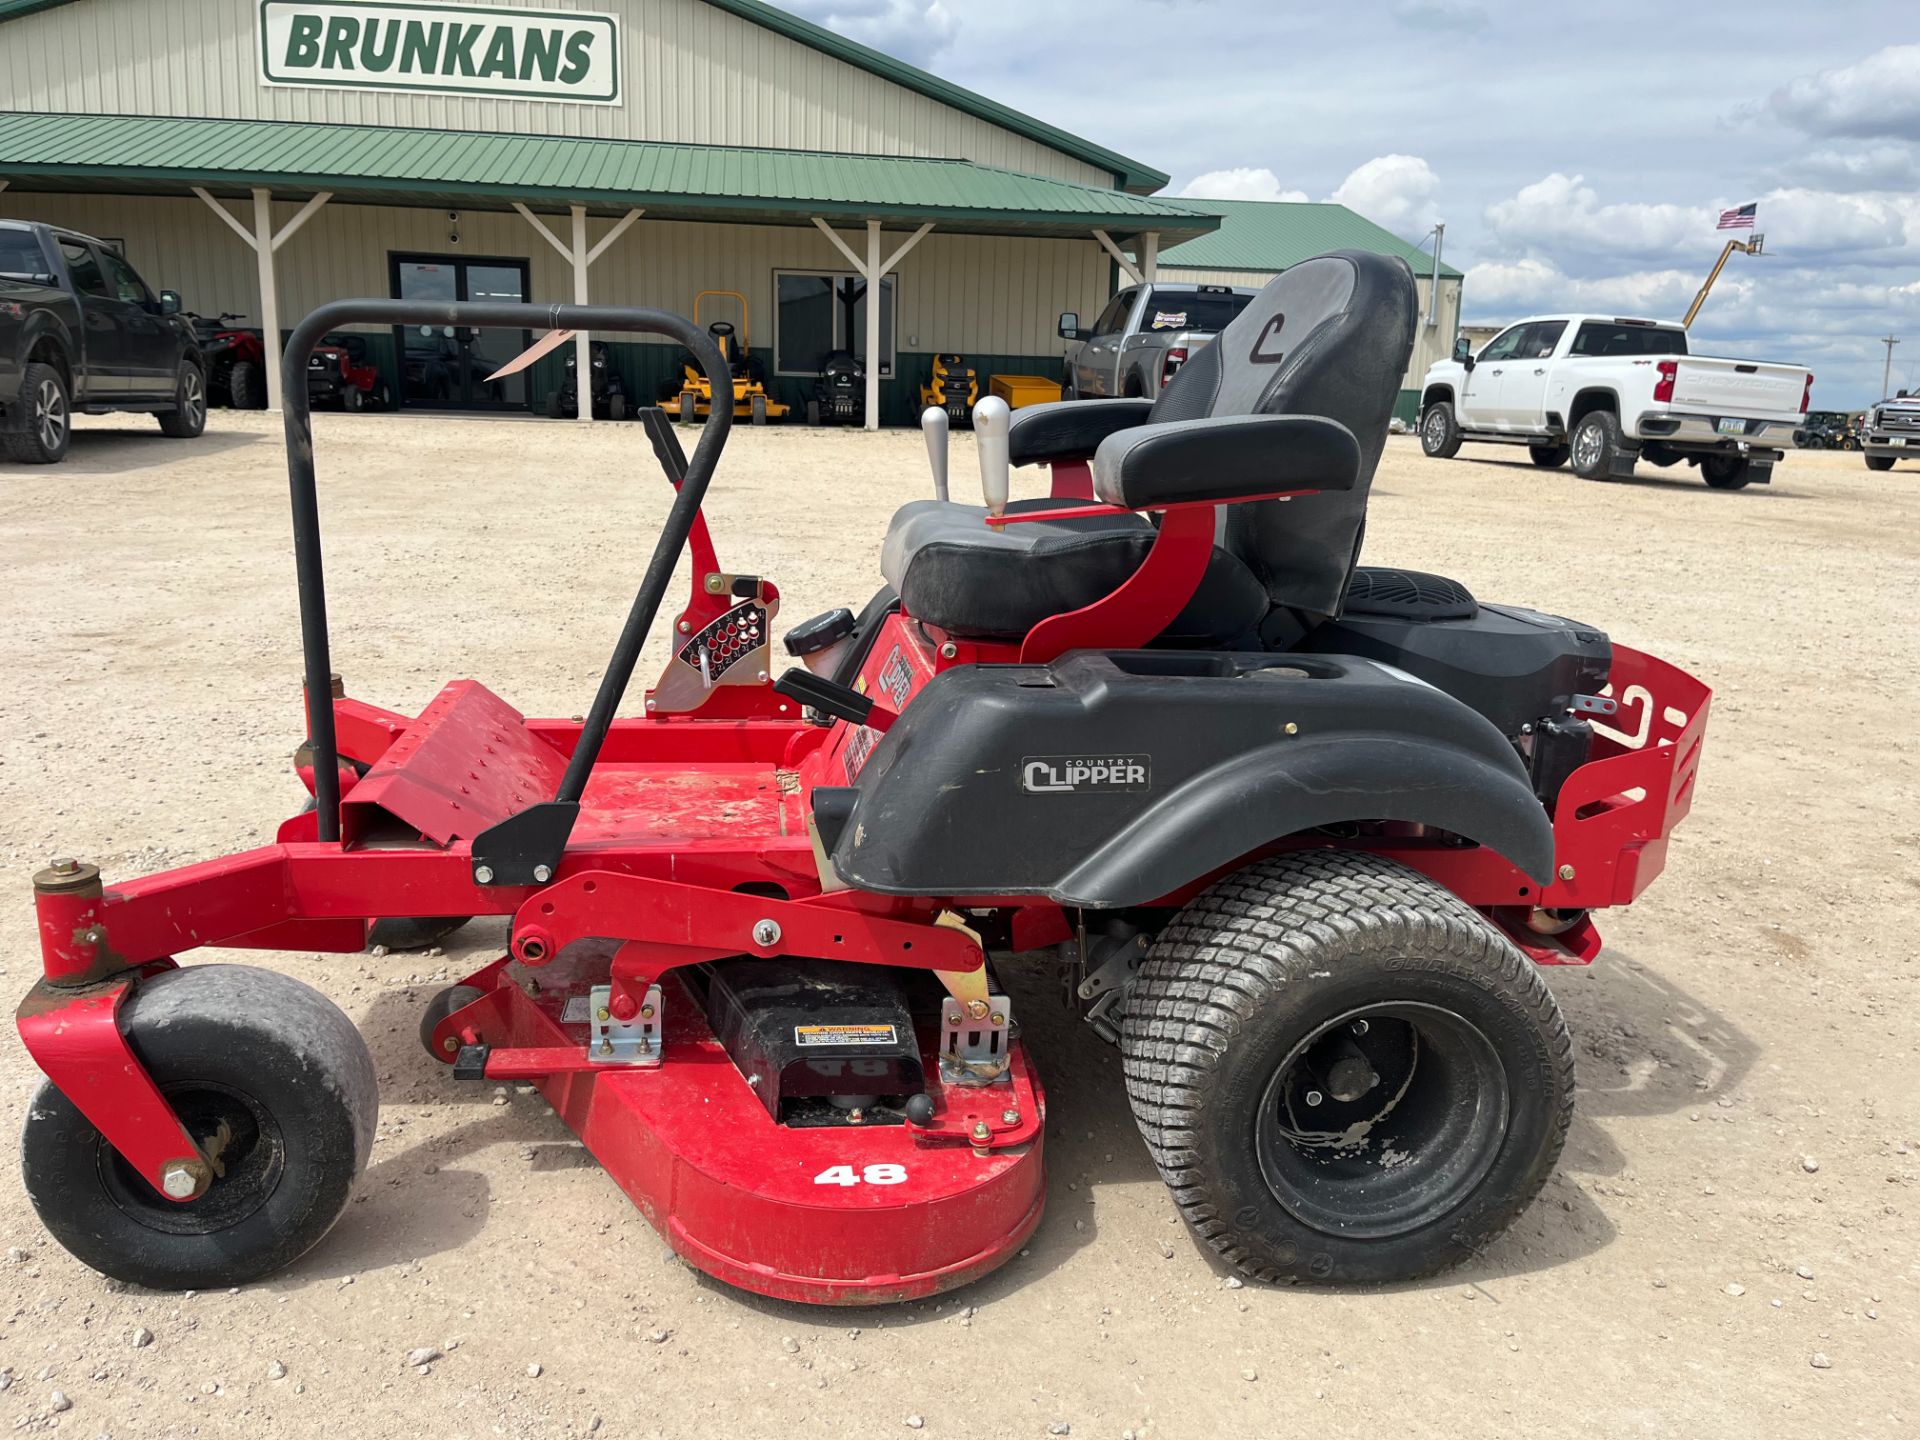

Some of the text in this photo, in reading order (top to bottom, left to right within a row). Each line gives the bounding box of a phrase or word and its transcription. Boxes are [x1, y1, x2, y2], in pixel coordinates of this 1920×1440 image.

[284, 14, 596, 85] BRUNKANS
[1024, 761, 1145, 792] CLIPPER
[1065, 758, 1135, 767] COUNTRY
[1384, 956, 1496, 992] GRASS
[813, 1163, 908, 1187] 48
